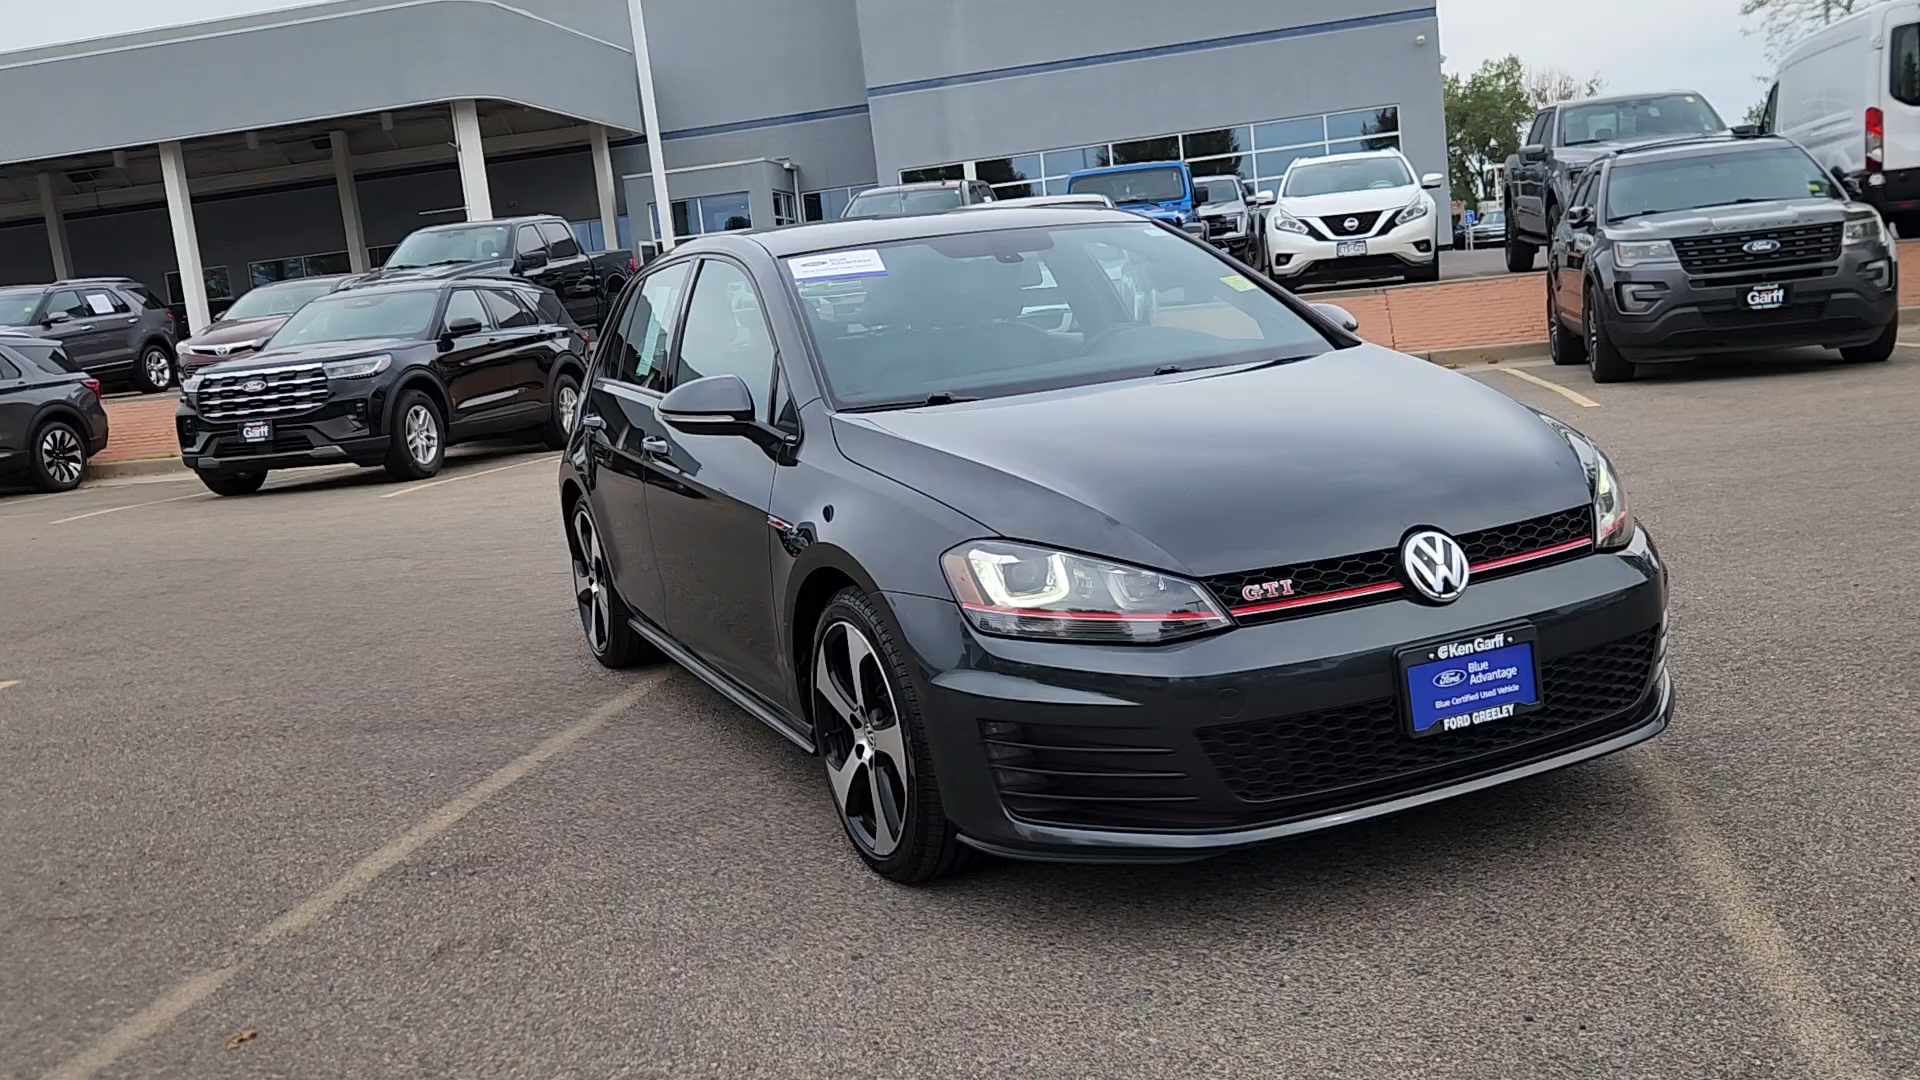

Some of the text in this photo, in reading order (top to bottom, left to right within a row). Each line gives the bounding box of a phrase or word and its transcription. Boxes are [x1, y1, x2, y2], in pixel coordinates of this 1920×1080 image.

[1747, 288, 1784, 305] Garff
[243, 425, 269, 438] Garff
[1242, 579, 1294, 601] GTI
[1449, 633, 1505, 658] Ken Garff
[1468, 661, 1489, 673] Blue
[1469, 666, 1518, 685] Advantage
[1439, 671, 1461, 685] Ford
[1435, 683, 1519, 709] Blue Certified Used Vehicle
[1443, 703, 1515, 731] FORD GREELEY
